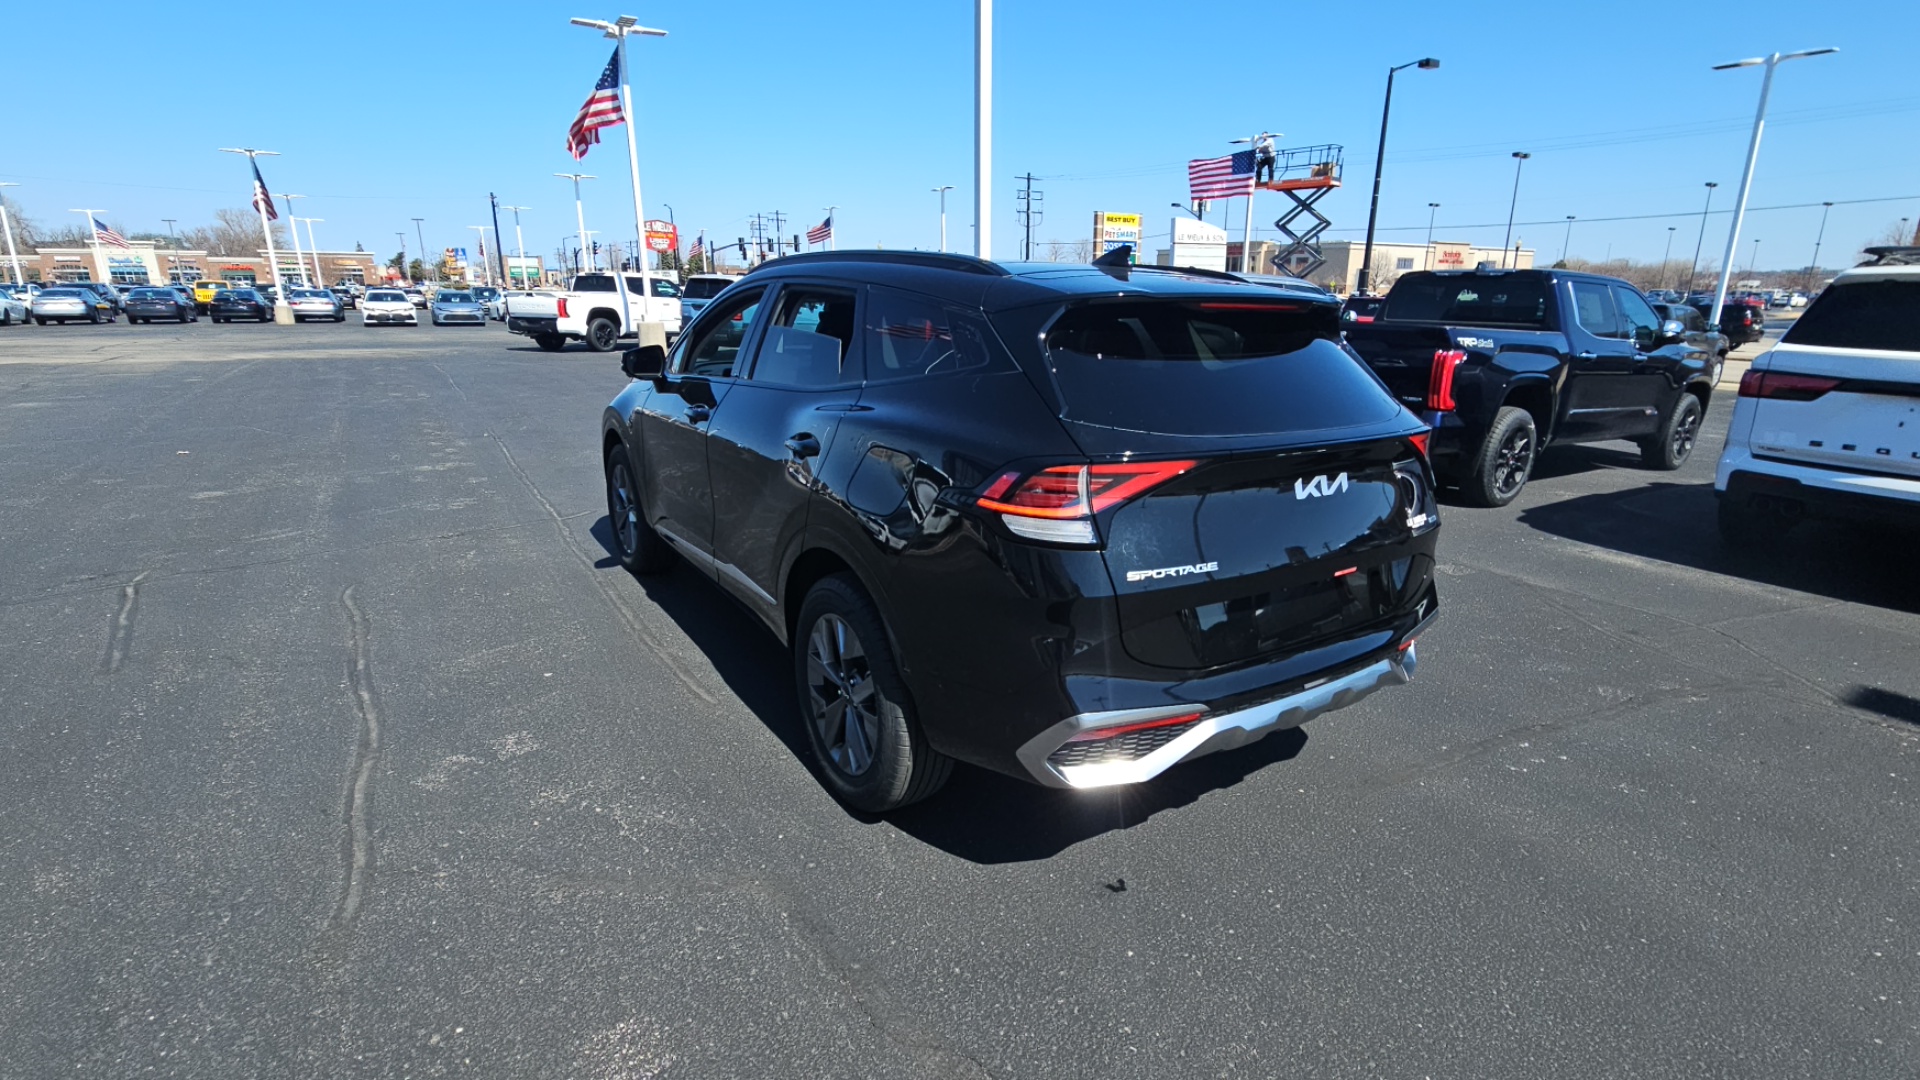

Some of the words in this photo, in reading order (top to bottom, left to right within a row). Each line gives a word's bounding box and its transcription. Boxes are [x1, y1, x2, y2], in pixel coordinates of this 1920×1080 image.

[1105, 230, 1137, 239] PETSMART
[1457, 337, 1478, 348] TRD
[1294, 472, 1349, 500] KIA
[1126, 561, 1219, 582] SPORTAGE
